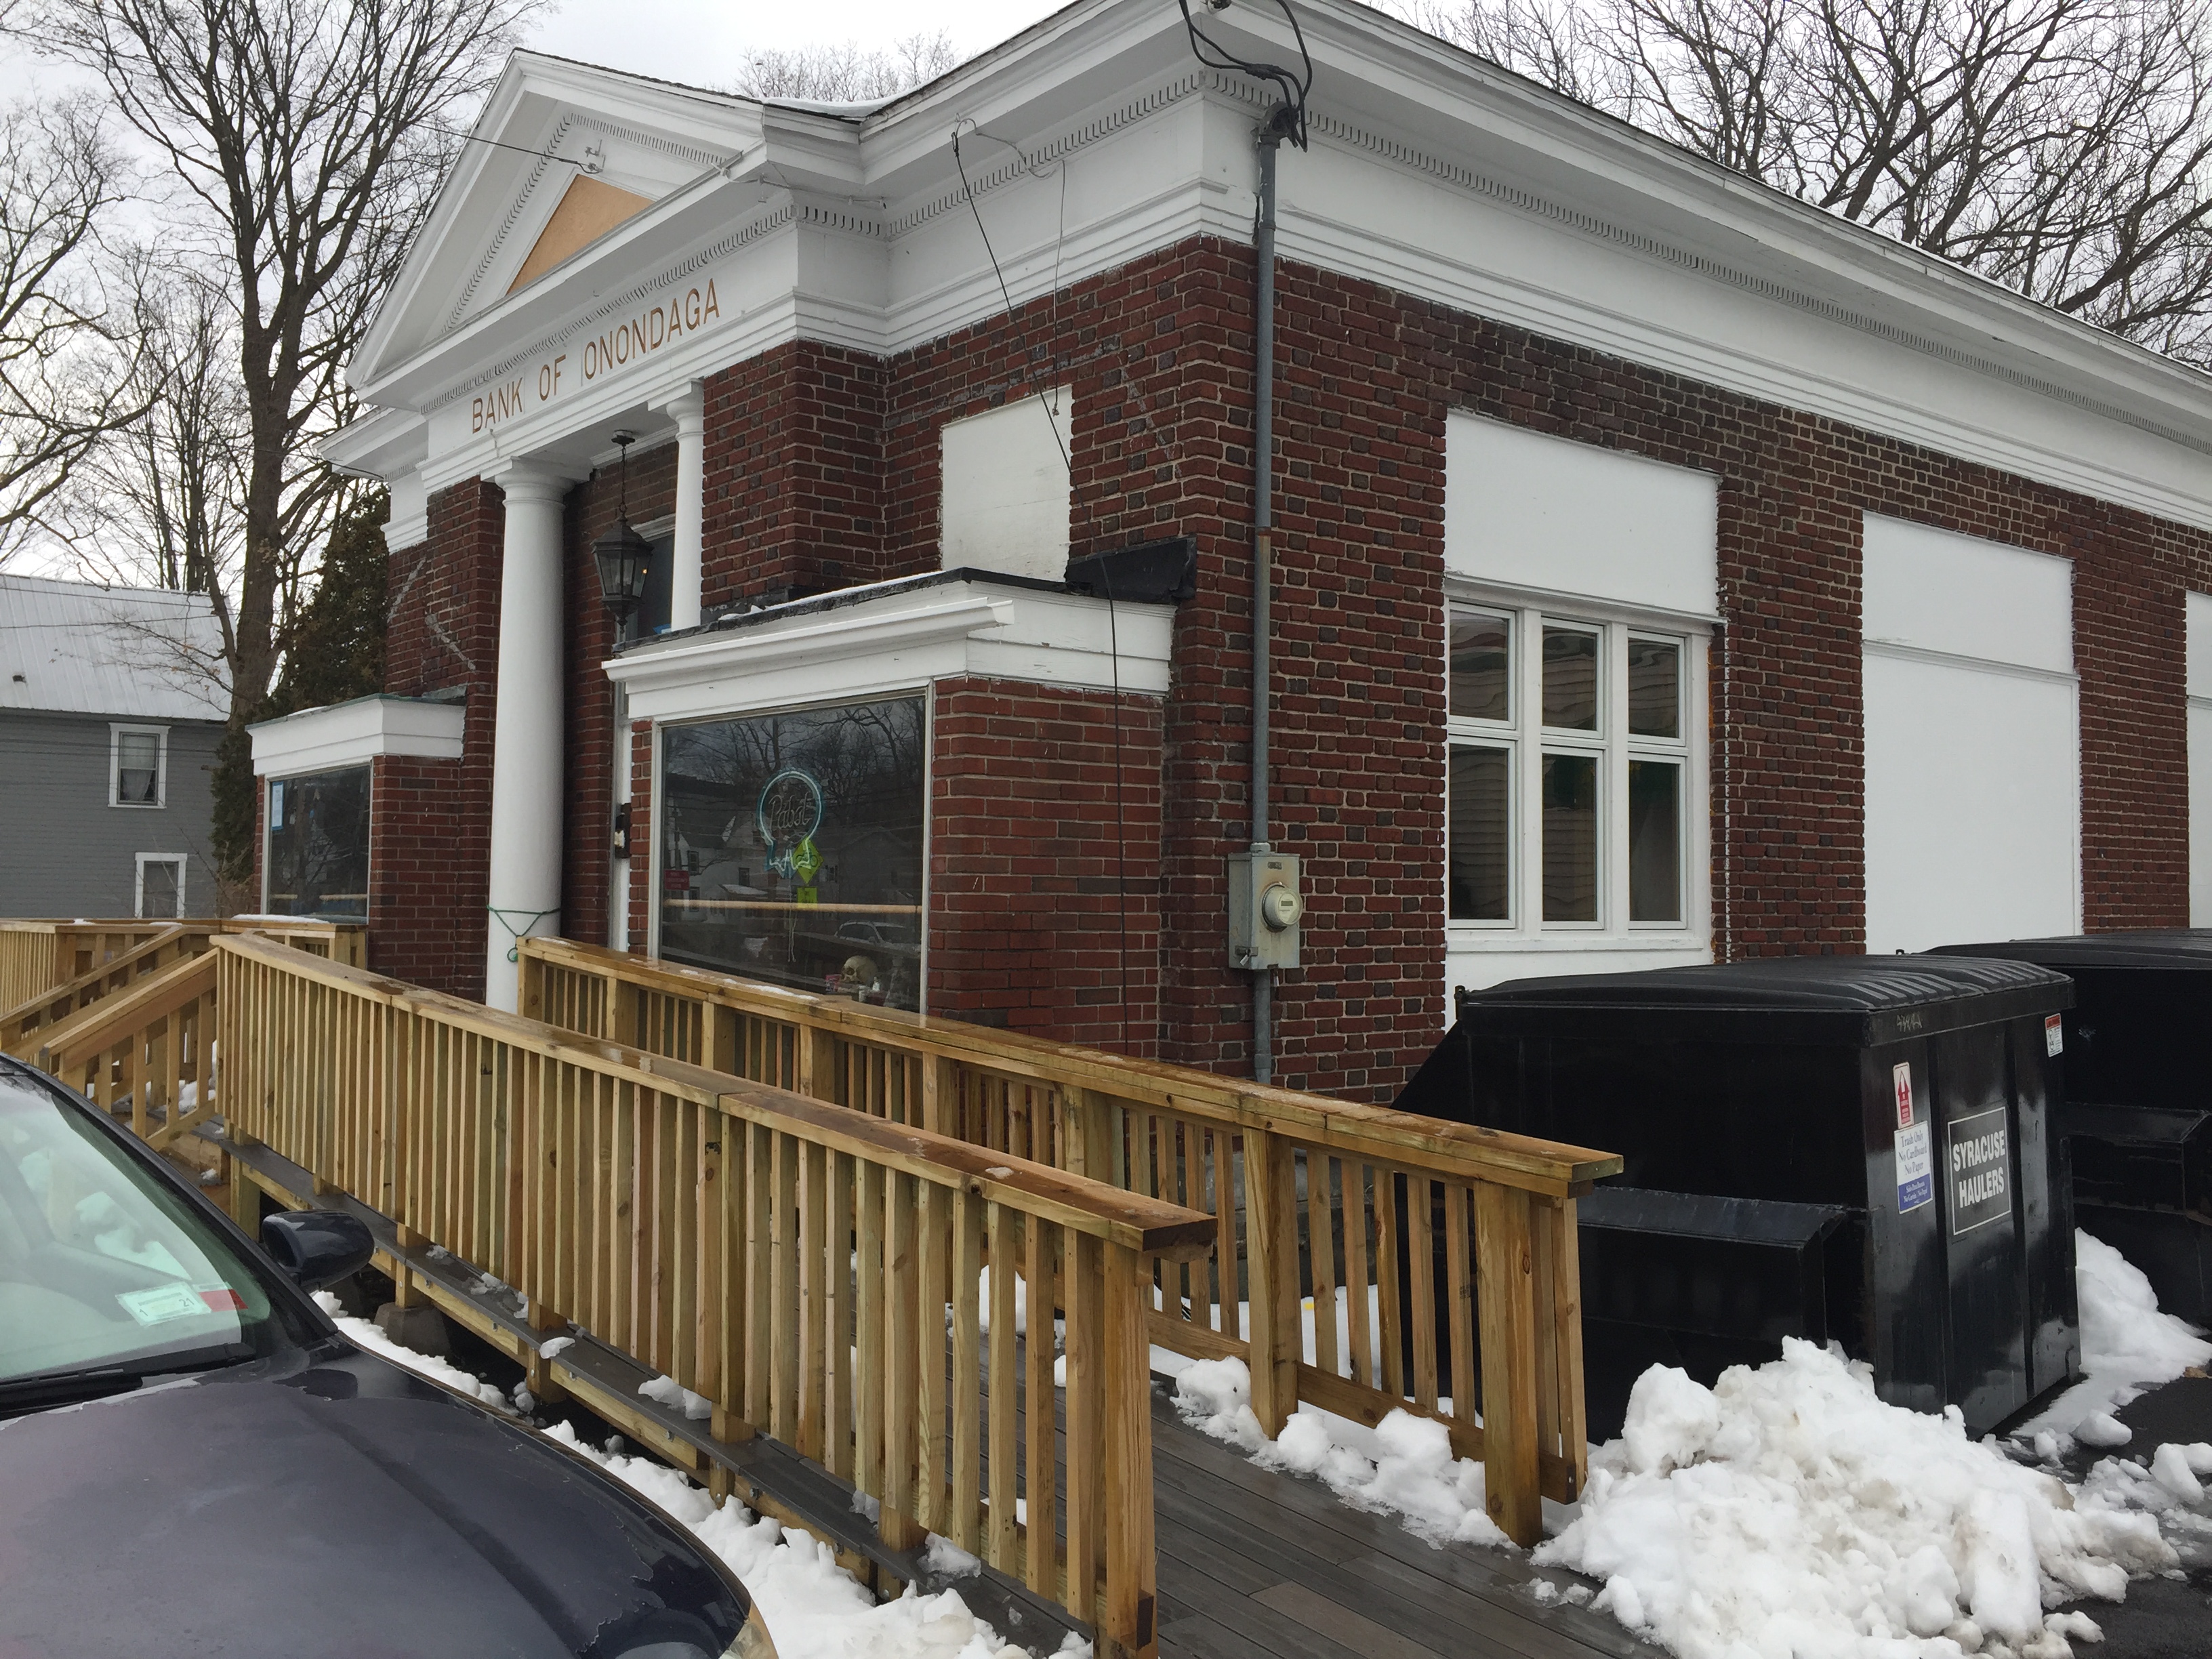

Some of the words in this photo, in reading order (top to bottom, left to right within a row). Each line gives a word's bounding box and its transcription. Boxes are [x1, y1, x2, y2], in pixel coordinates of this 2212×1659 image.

[472, 377, 524, 434] BANK
[539, 354, 567, 401] OF
[584, 278, 720, 380] ONONDAGA
[769, 792, 813, 832] Pabst
[1953, 1130, 2006, 1172] SYRACUSE
[1959, 1166, 2005, 1208] HAULERS
[139, 1309, 148, 1317] 1
[178, 1297, 194, 1307] 21
